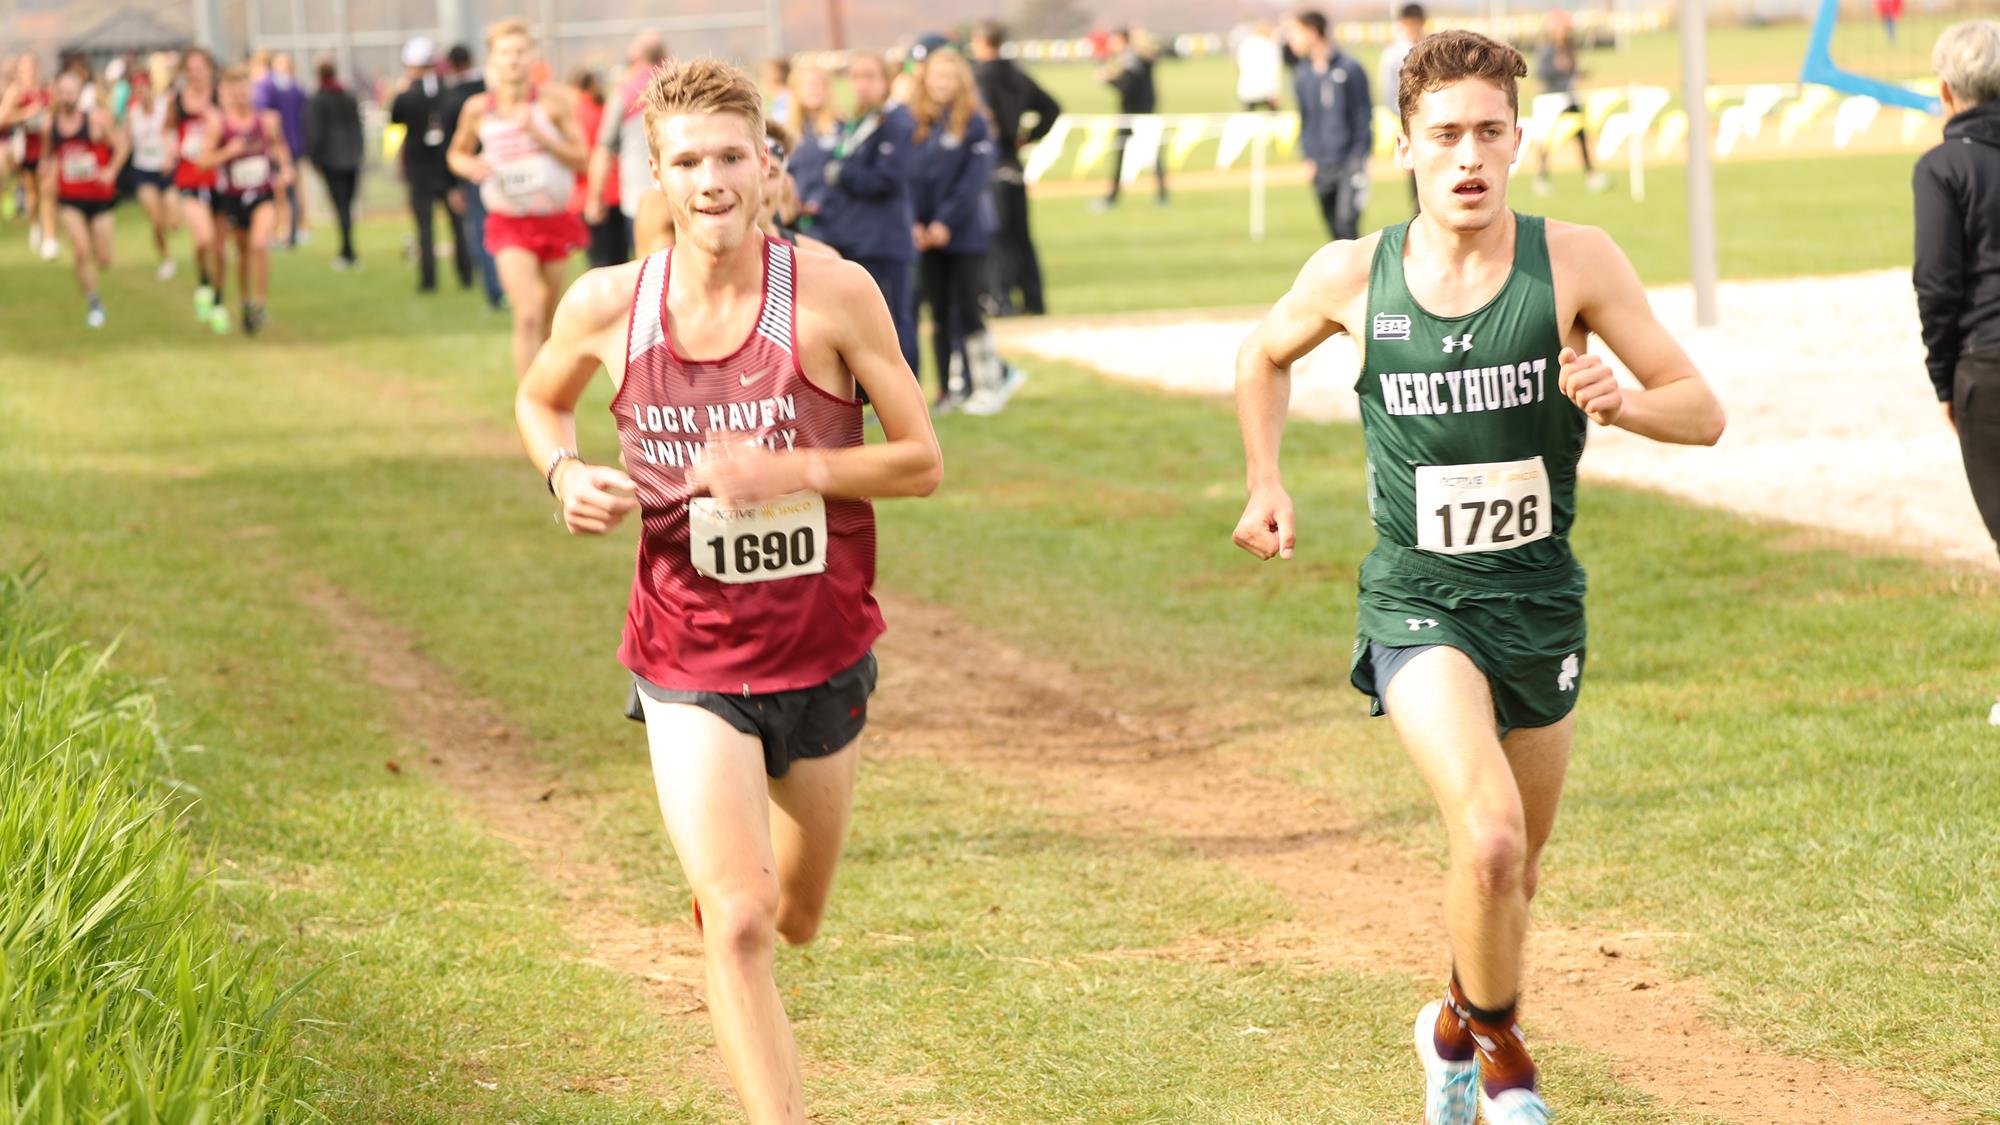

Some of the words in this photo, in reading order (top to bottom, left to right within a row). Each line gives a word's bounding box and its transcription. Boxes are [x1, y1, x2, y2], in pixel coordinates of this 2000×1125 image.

[1379, 358, 1547, 416] MERCYHURST
[633, 403, 700, 433] LOCK
[705, 393, 796, 432] HAVEN
[640, 428, 797, 468] UNIVETY
[1435, 494, 1538, 548] 1726
[707, 526, 815, 574] 1690
